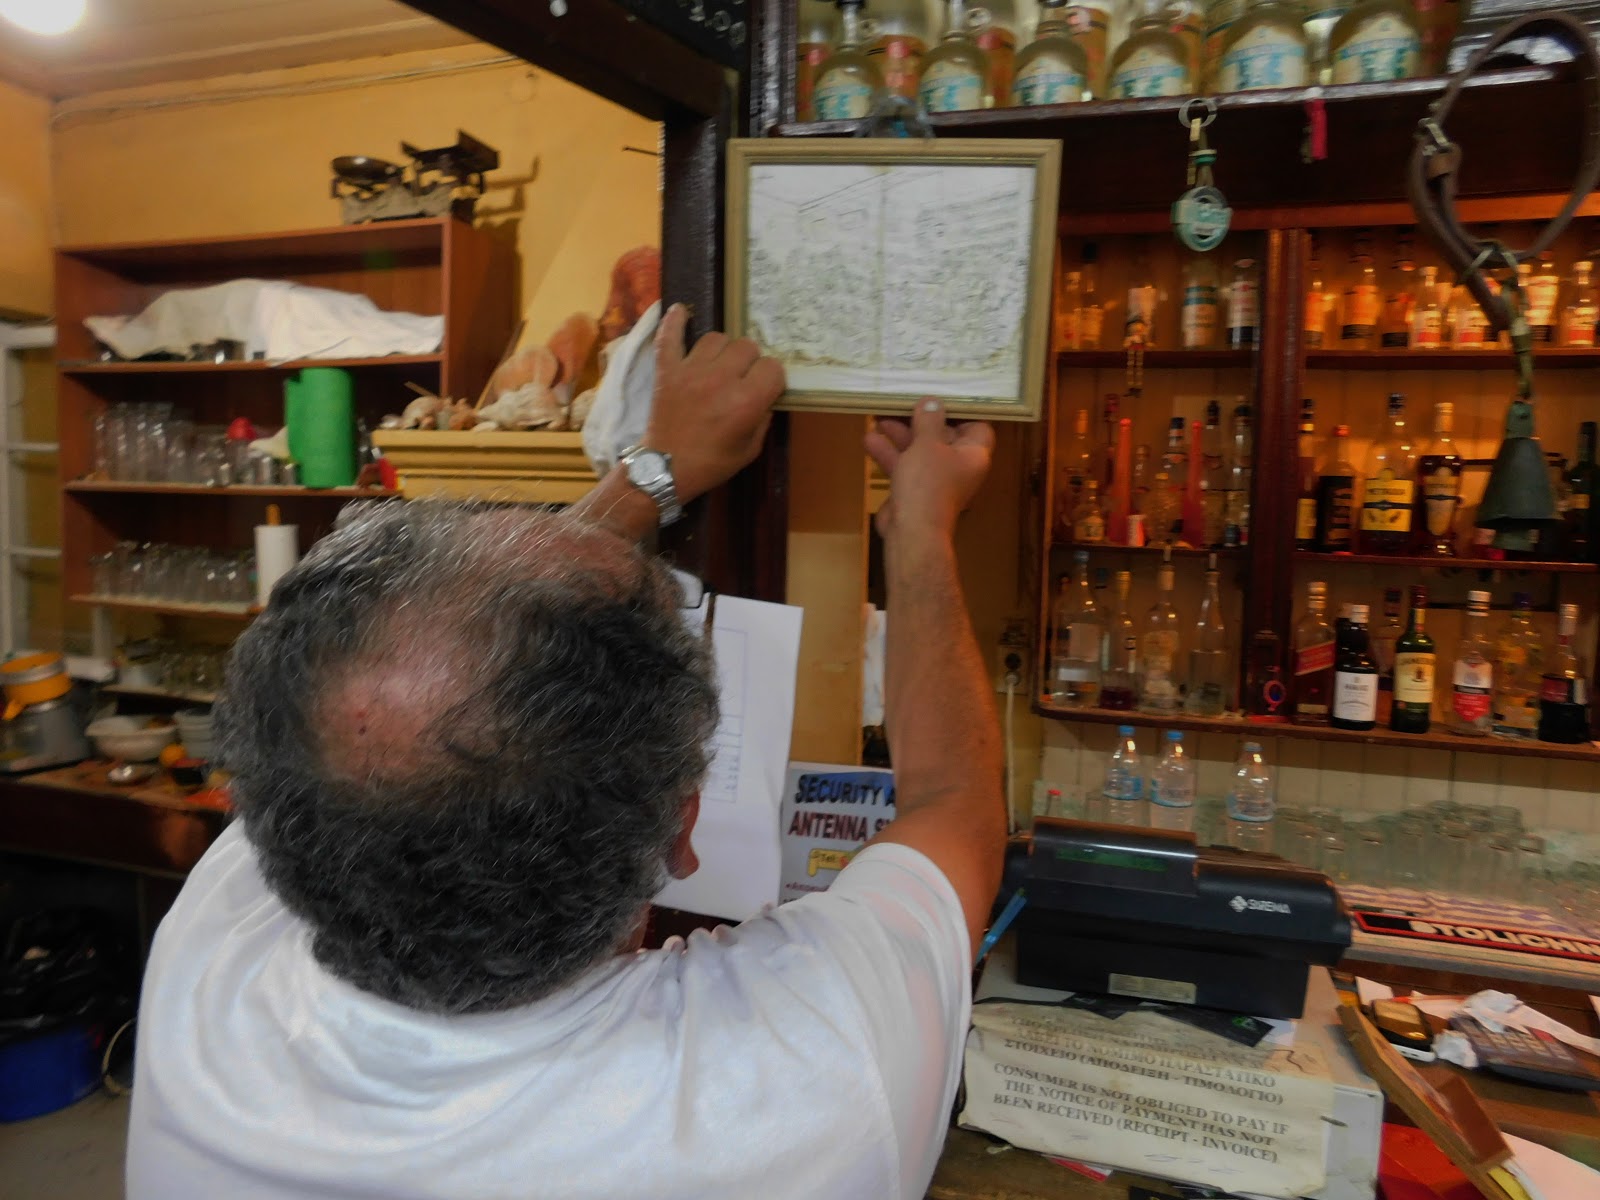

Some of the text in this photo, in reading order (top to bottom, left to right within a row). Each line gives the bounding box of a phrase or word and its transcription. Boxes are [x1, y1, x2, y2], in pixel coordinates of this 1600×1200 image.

[795, 774, 882, 805] SECURITY
[787, 810, 868, 841] ANTENNA
[1004, 1038, 1077, 1061] ΣΤΟΙΧΕΙΟ
[994, 1062, 1290, 1135] CONSUMER IS NOT OBLIGED TO PAY IF
[1004, 1079, 1276, 1146] THE NOTICE OF PAYMENT HAS NOT
[993, 1093, 1032, 1109] BEEN
[1036, 1101, 1113, 1126] RECEIVED
[1117, 1117, 1190, 1143] (RECEIPT
[1202, 1136, 1278, 1163] INVOICE)
